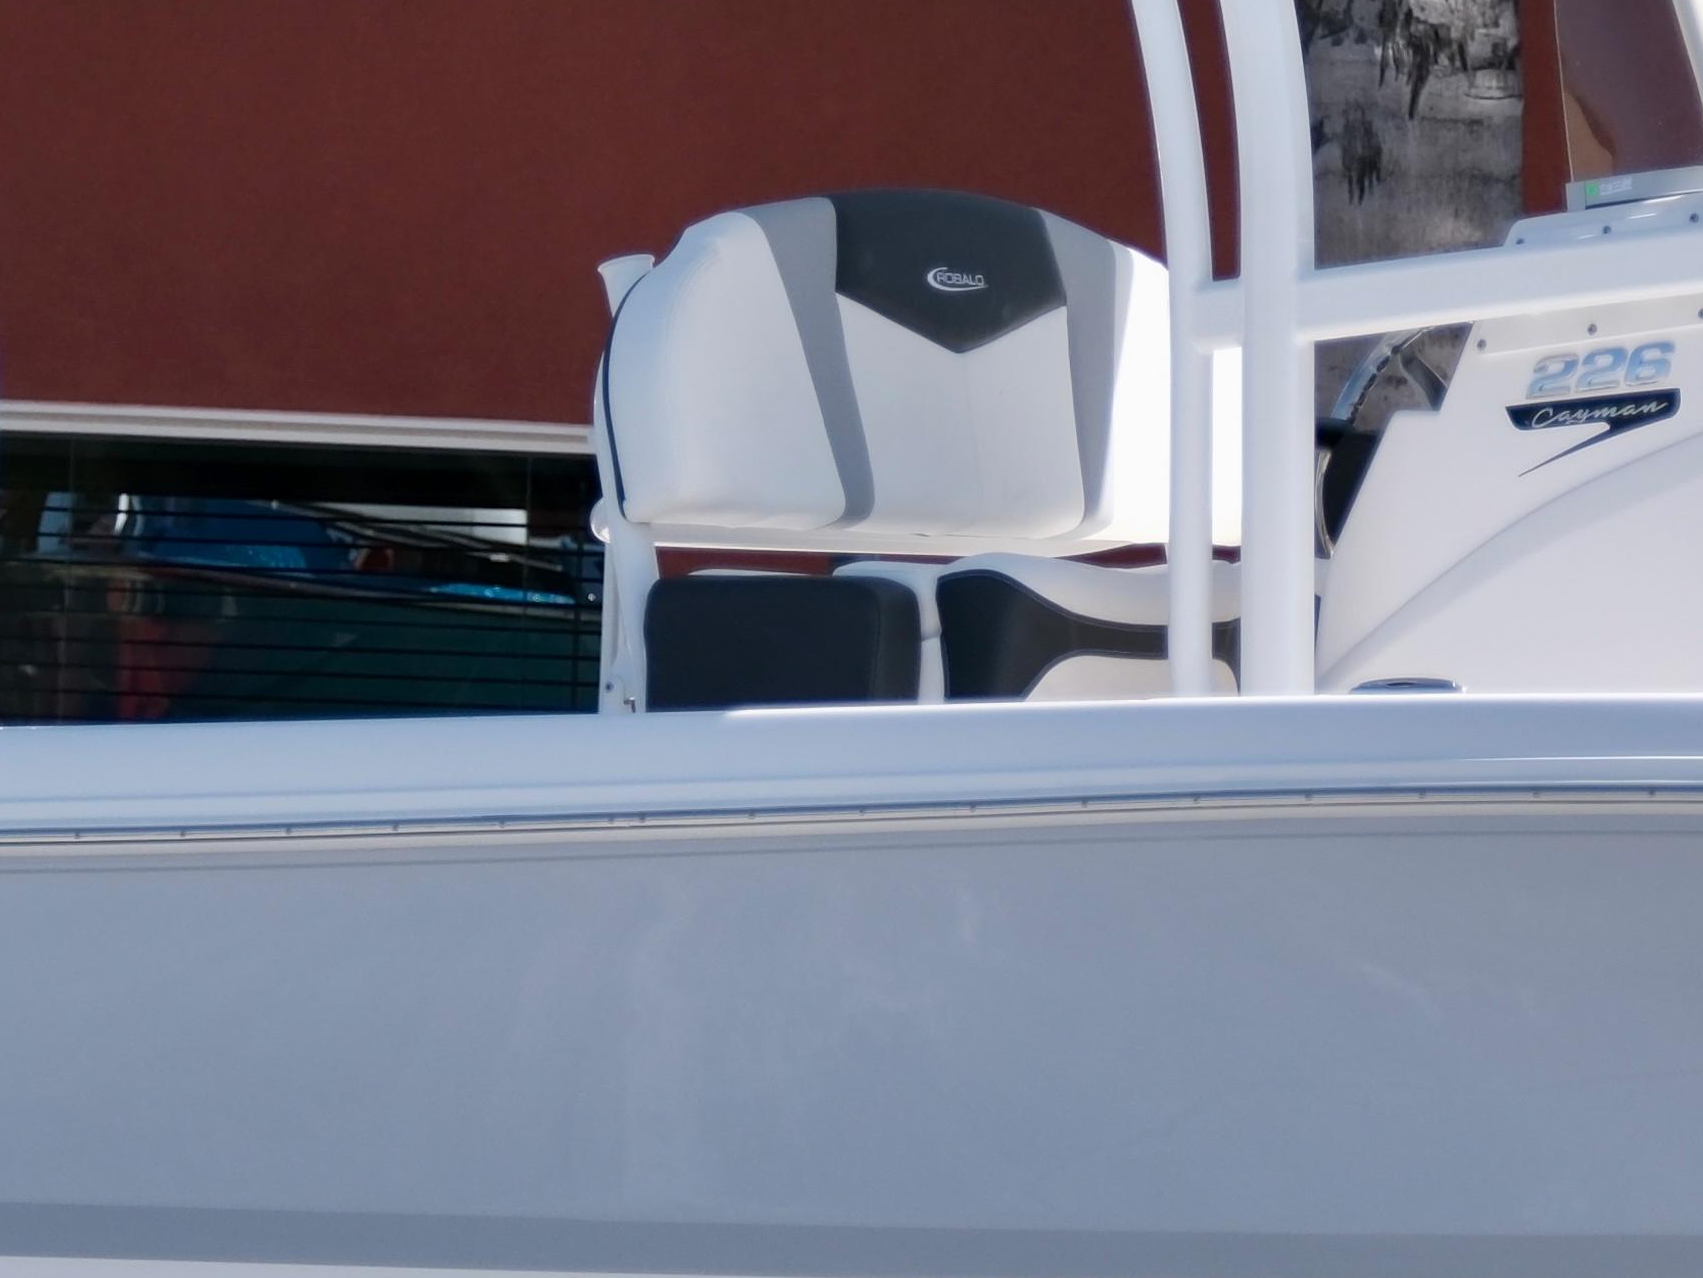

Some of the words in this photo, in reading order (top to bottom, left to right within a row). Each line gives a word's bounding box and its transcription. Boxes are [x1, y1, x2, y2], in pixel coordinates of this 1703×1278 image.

[936, 272, 984, 285] ROBALO
[1527, 340, 1675, 399] 226
[1530, 401, 1669, 428] Cayman
